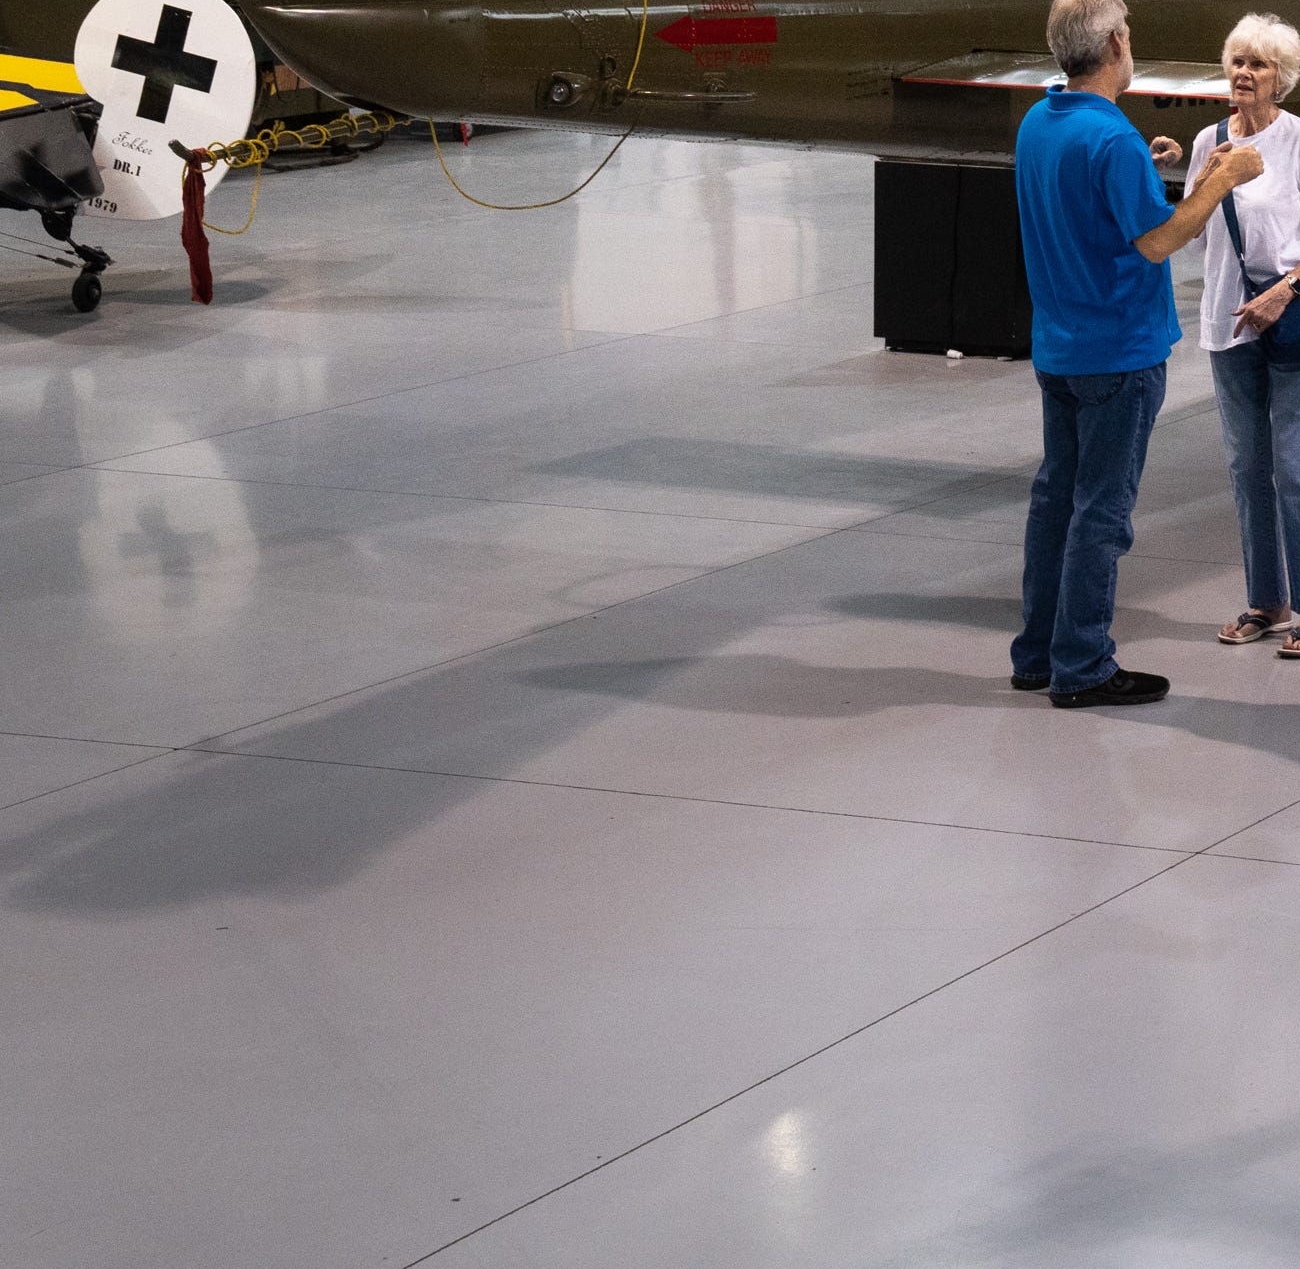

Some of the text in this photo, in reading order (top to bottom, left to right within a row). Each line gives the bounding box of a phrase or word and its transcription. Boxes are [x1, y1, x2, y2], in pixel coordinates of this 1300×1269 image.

[695, 48, 772, 68] KEEP AWAY
[112, 131, 153, 155] Fokker
[88, 197, 117, 213] 1979
